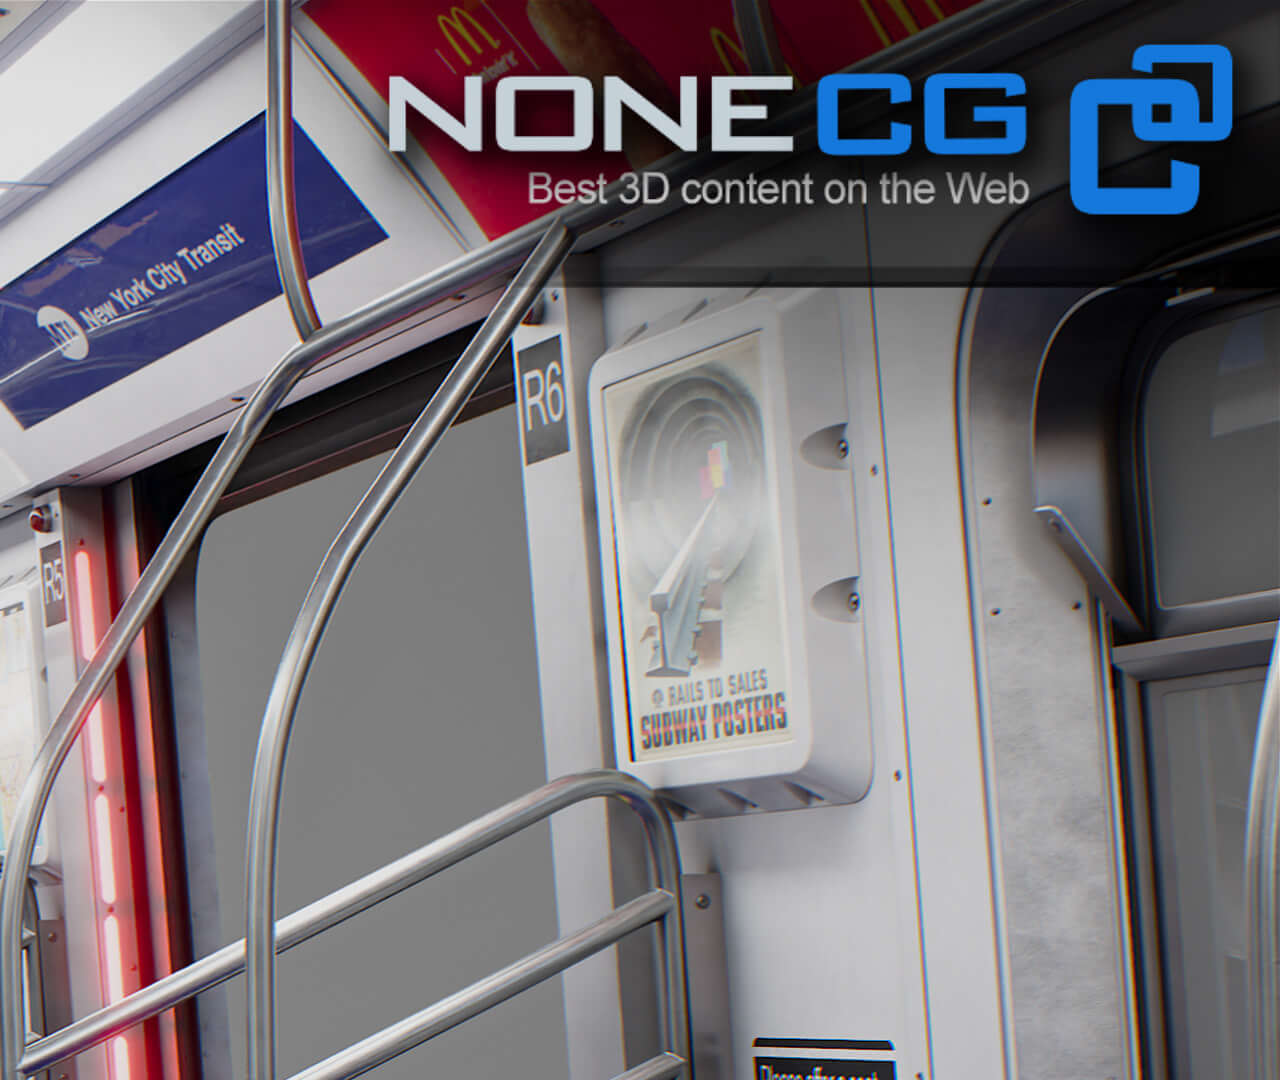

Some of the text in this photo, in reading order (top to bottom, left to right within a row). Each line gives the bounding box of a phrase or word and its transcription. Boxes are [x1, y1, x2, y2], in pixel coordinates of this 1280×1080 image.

[79, 300, 120, 331] New
[109, 278, 156, 312] York
[146, 261, 188, 290] City
[176, 222, 246, 271] Transit
[522, 360, 565, 432] R6
[43, 558, 65, 605] R5
[667, 668, 769, 707] RAILS TO SALES
[640, 691, 788, 750] SUBWAY POSTERS
